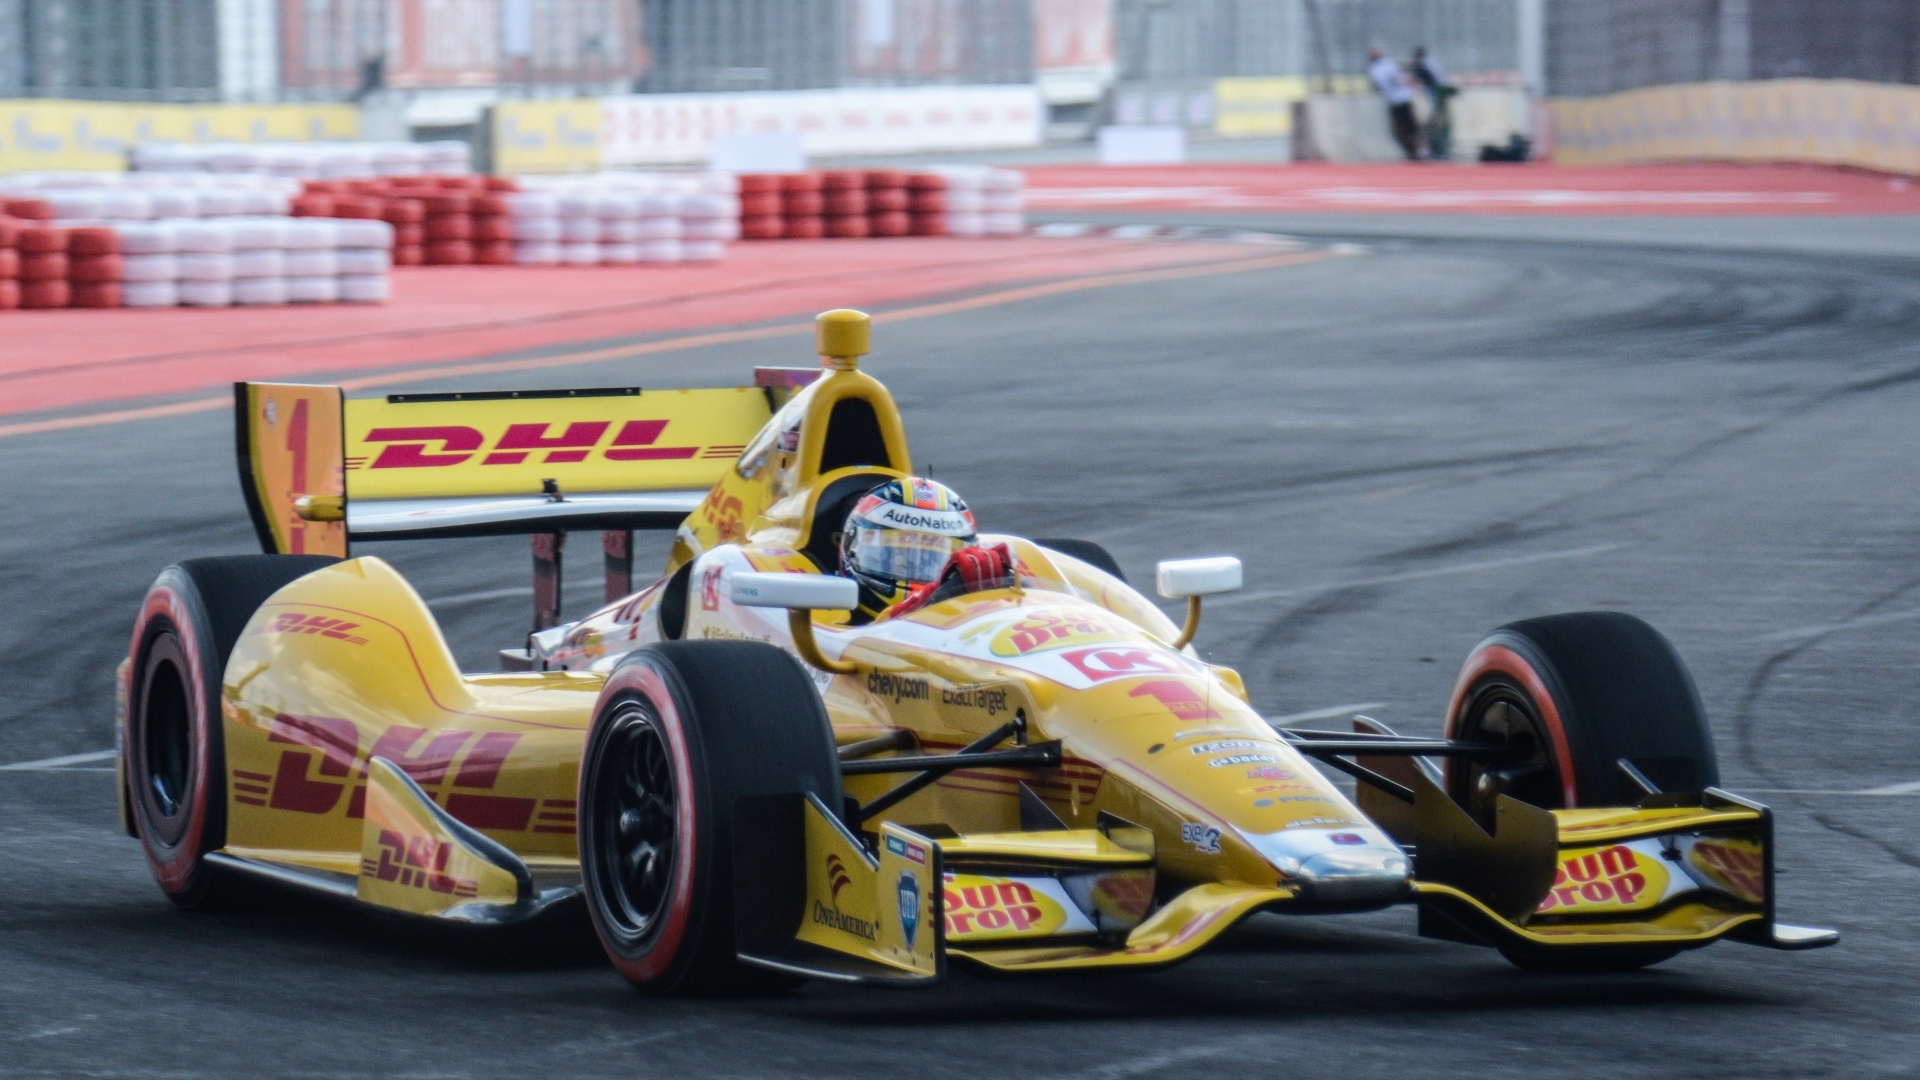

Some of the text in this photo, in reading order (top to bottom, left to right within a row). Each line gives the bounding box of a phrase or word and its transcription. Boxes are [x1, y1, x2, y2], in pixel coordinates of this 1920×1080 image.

[364, 419, 700, 469] DHL
[883, 508, 964, 531] AutoNation
[274, 612, 361, 640] DHL
[867, 667, 930, 704] chevy.com
[942, 678, 1007, 716] ExactTarget
[267, 712, 538, 832] DHL
[376, 828, 456, 895] DHL
